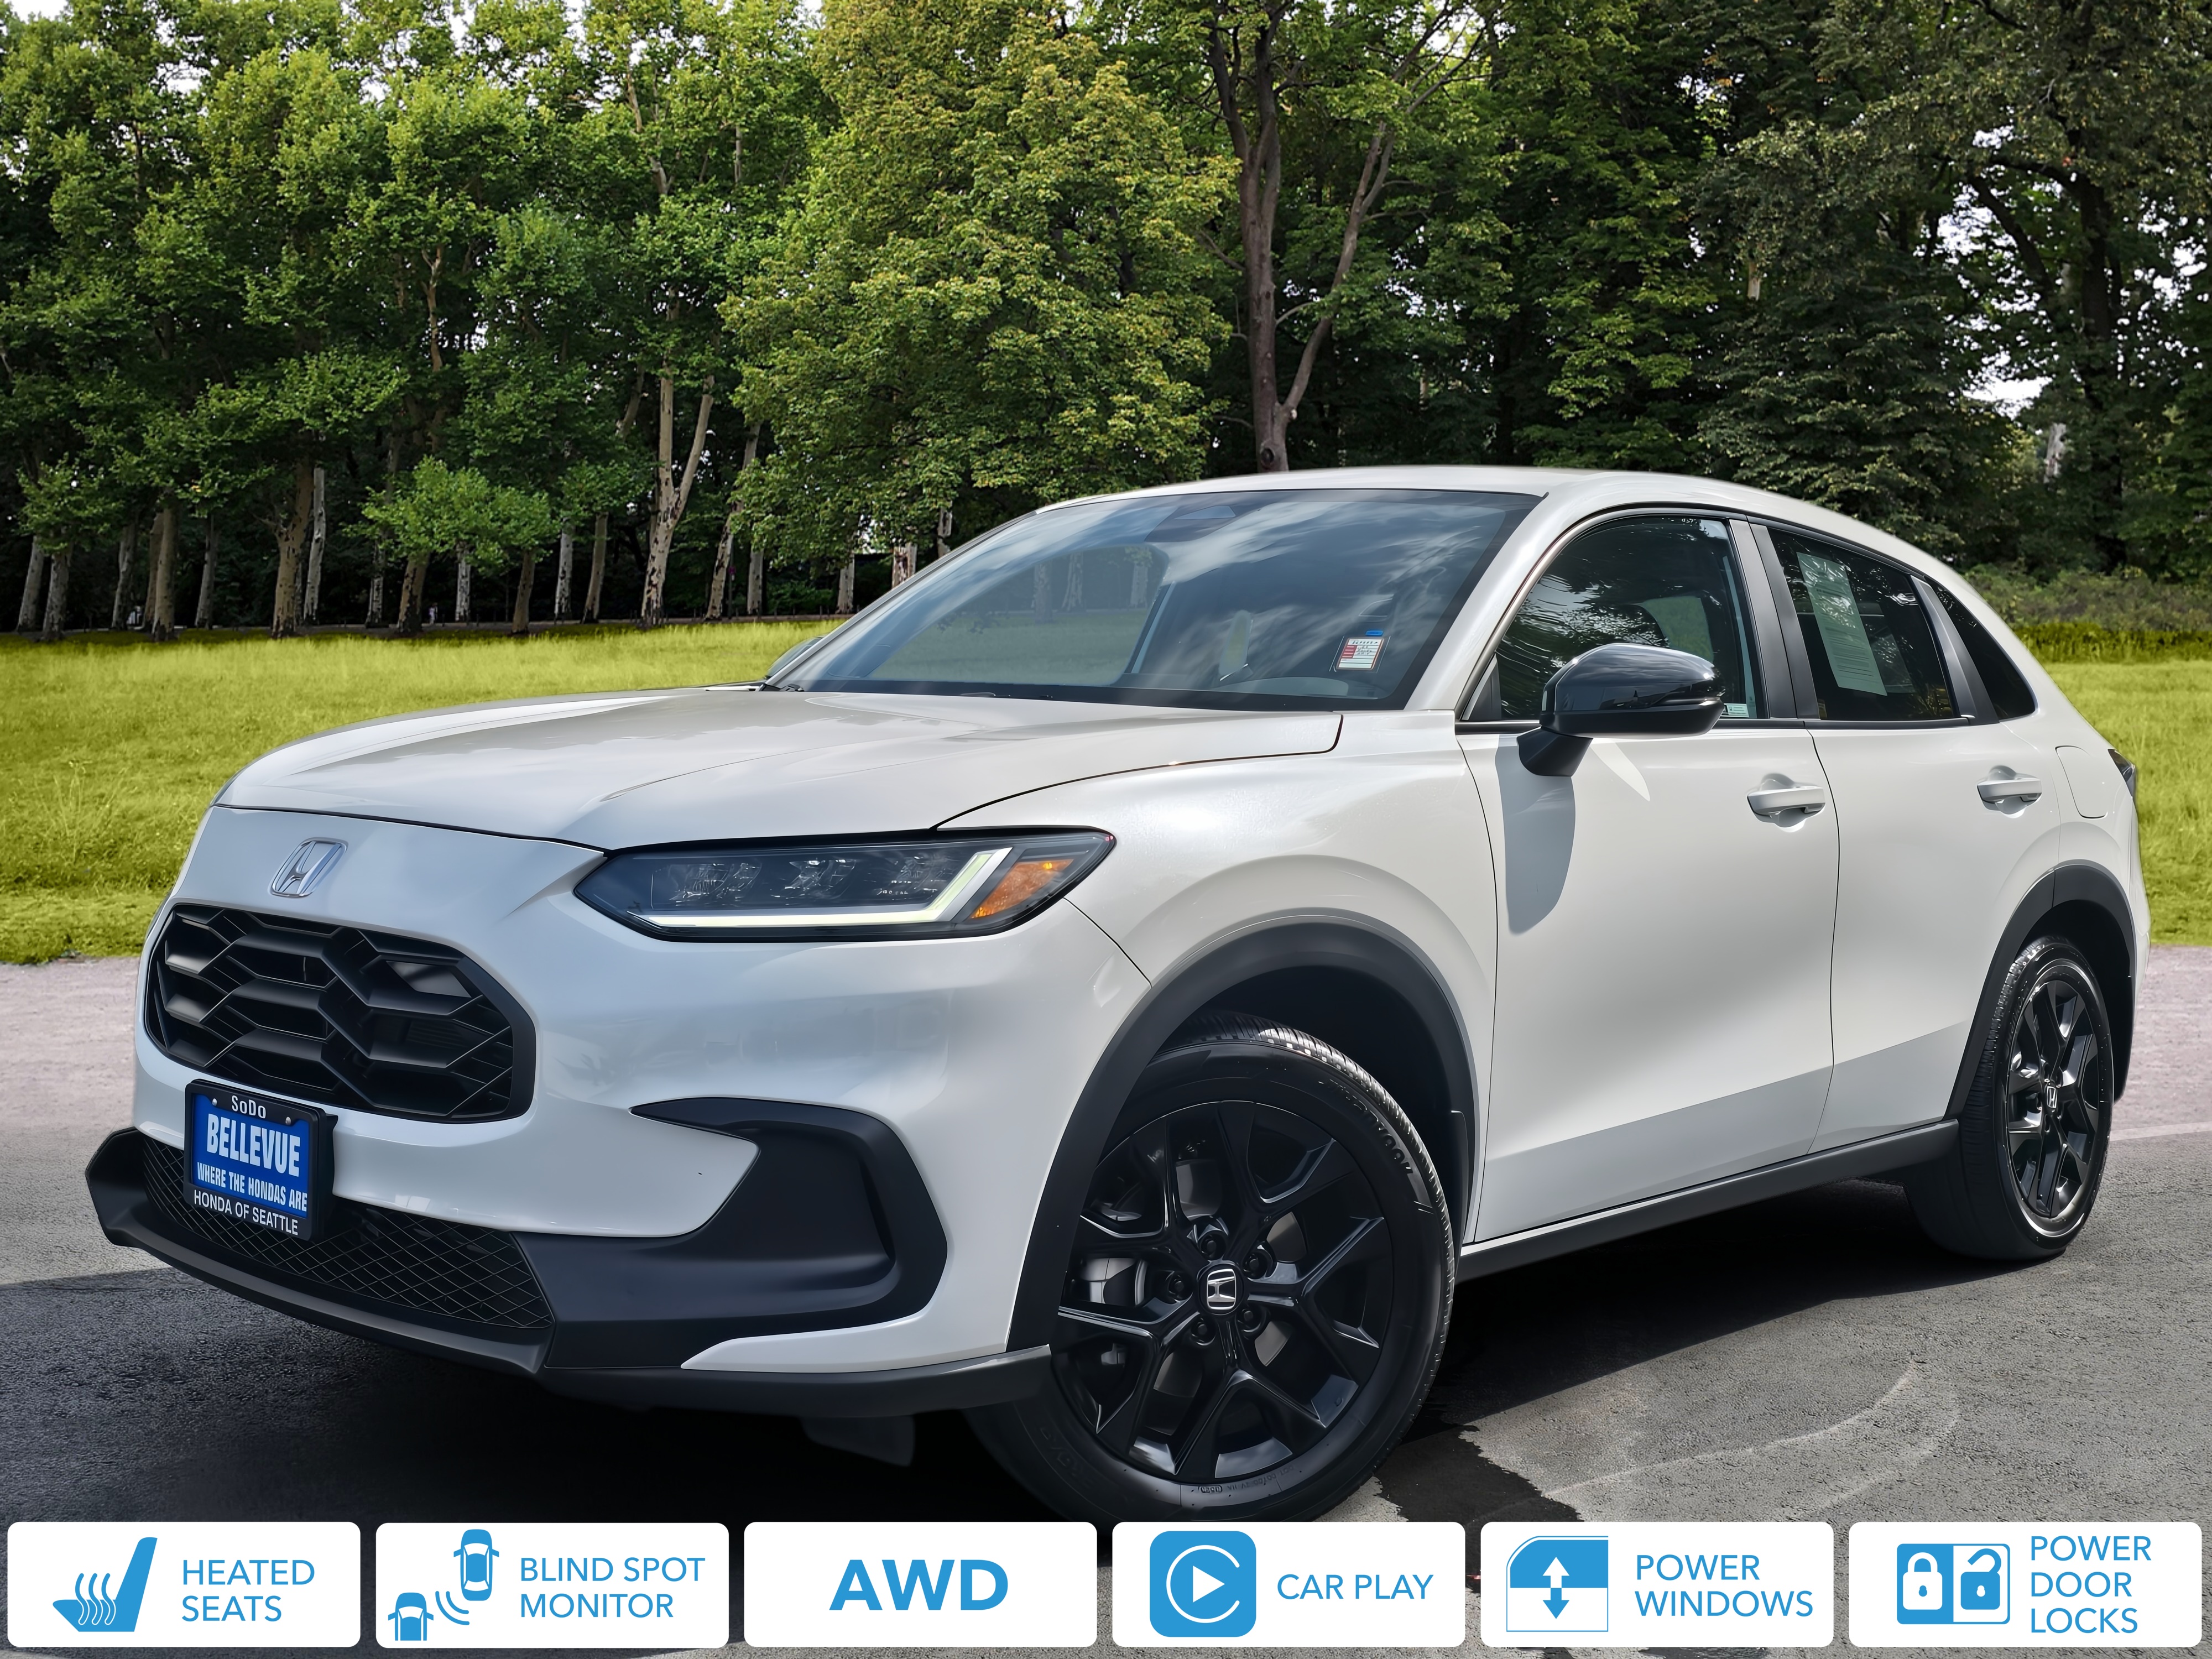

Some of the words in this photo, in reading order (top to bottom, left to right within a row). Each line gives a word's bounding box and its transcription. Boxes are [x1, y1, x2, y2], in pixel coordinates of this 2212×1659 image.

[231, 1095, 267, 1119] SoDo
[207, 1113, 300, 1177] BELLEVUE
[197, 1162, 226, 1188] WHERE
[228, 1171, 245, 1193] THE
[248, 1177, 286, 1206] HONDAS
[289, 1189, 307, 1212] ARE
[194, 1190, 232, 1214] HONDA
[235, 1202, 249, 1219] OF
[253, 1207, 298, 1235] SEATTLE
